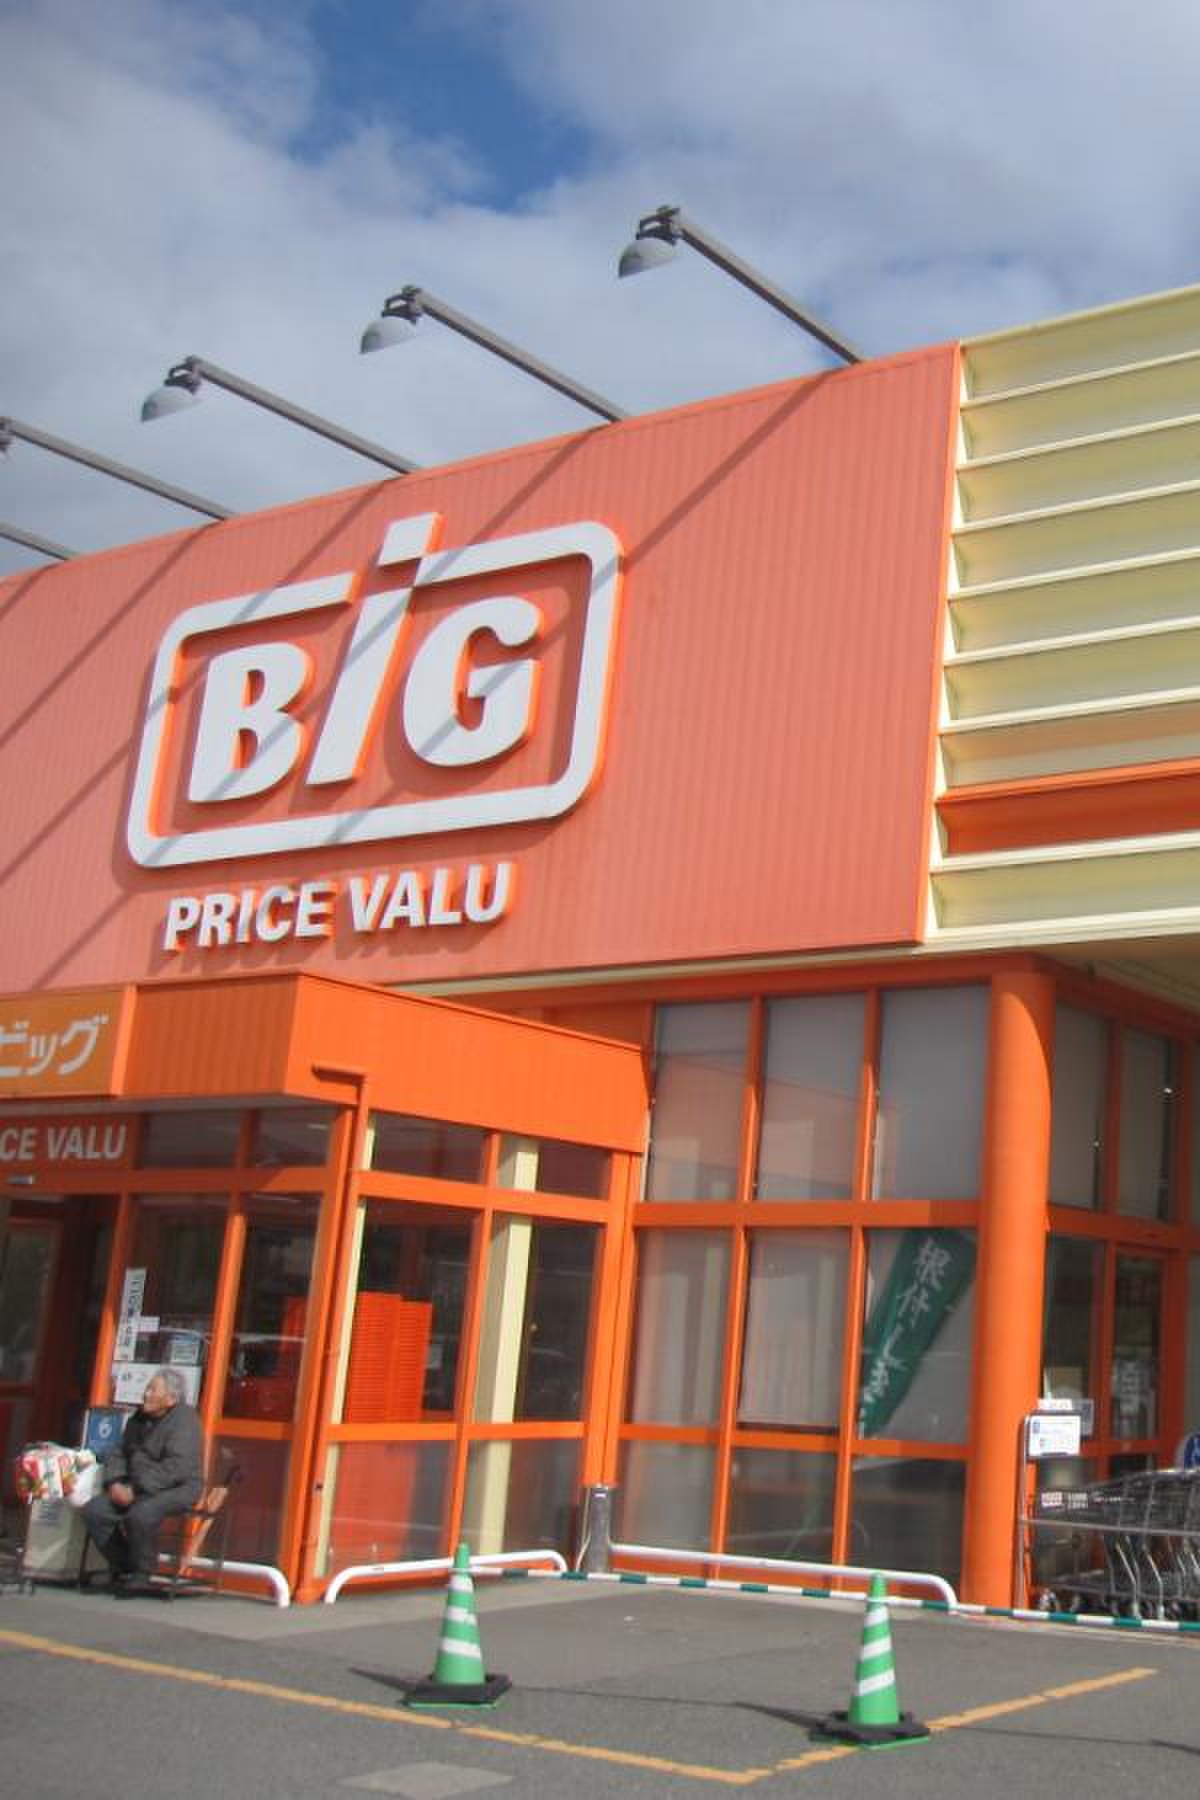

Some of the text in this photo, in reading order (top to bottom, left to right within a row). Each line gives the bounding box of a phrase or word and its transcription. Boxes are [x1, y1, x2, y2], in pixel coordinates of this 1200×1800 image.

[164, 863, 514, 950] PRICE VALU
[47, 1124, 126, 1160] VALU
